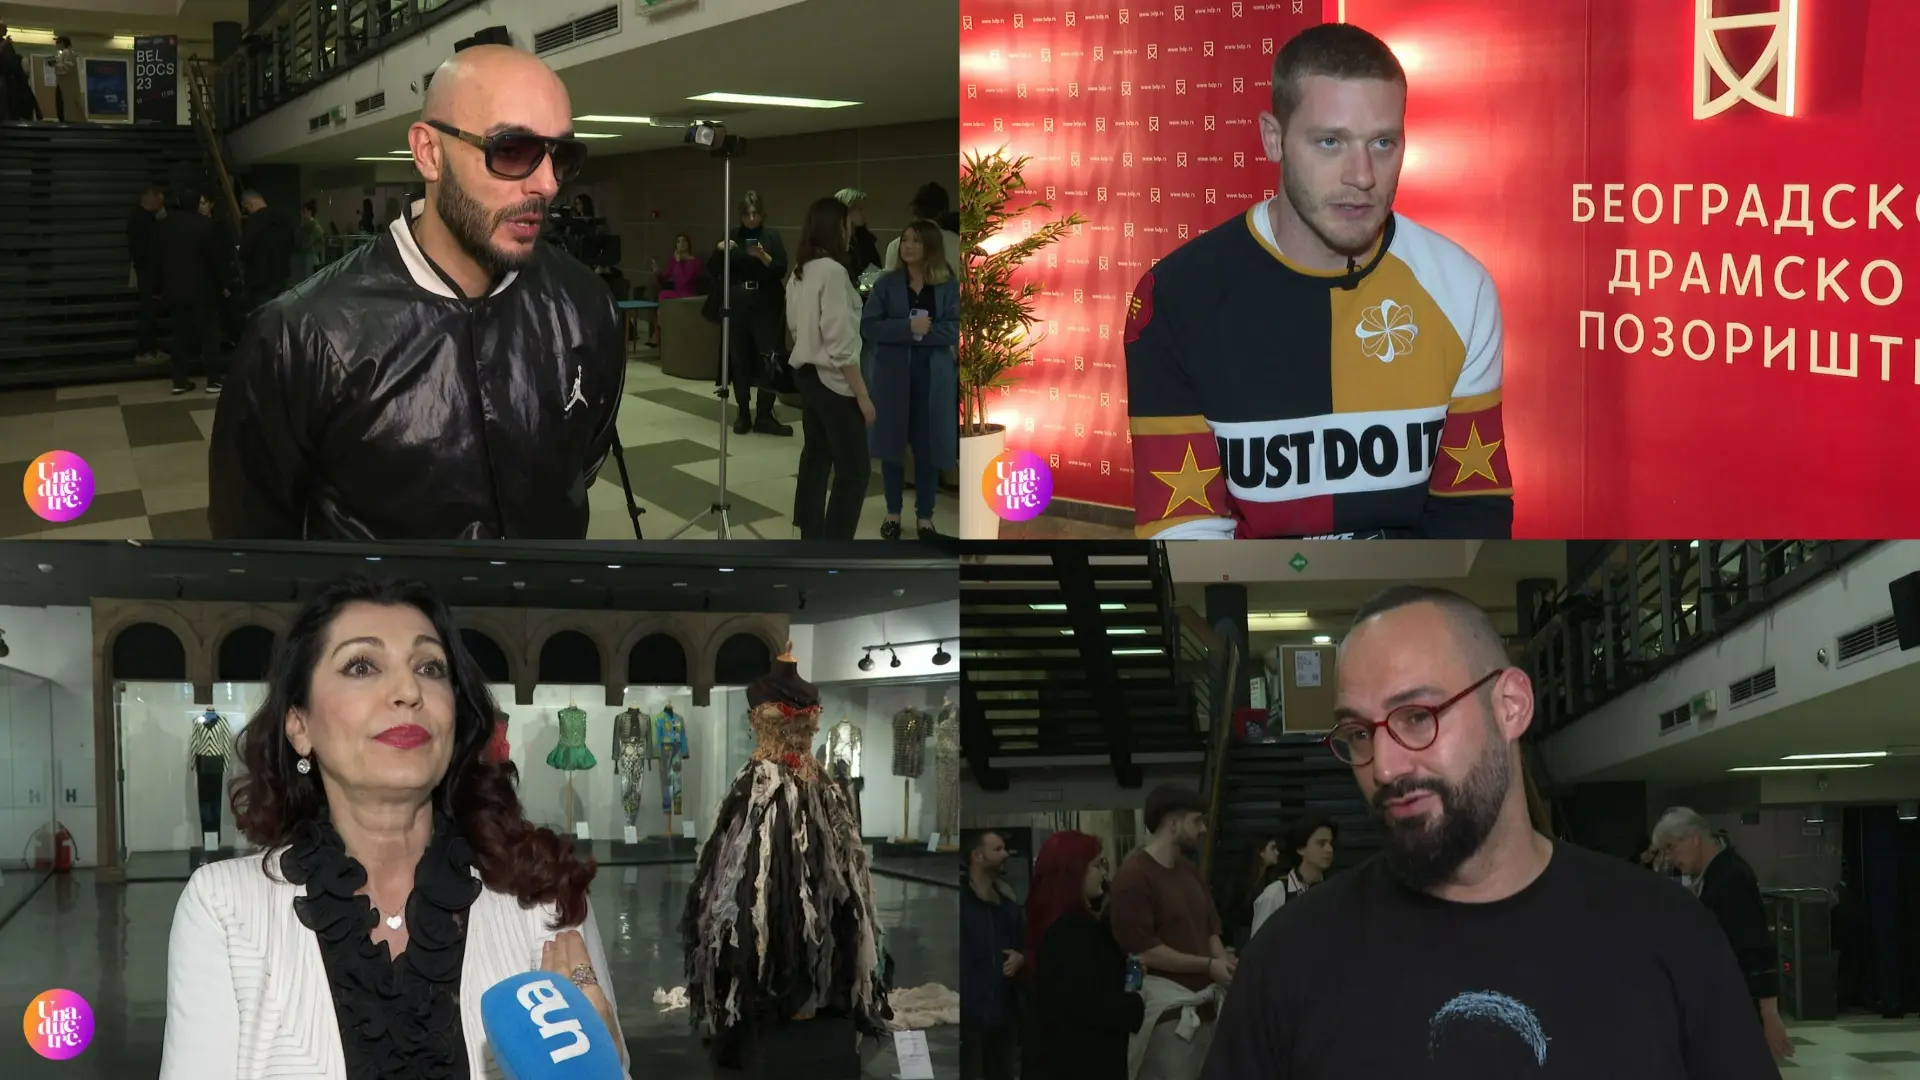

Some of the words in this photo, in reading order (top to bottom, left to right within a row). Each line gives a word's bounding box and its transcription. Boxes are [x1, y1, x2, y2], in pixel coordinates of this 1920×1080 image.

[1195, 7, 1221, 15] www.bdp.rs
[1253, 3, 1281, 11] www.bdp.rs
[1167, 45, 1193, 53] www.bdp.rs
[1224, 43, 1251, 51] www.bdp.rs
[136, 49, 163, 62] BEL
[1113, 48, 1137, 56] www.bdp.rs
[136, 63, 175, 76] DOCS
[136, 77, 152, 90] 23
[1140, 83, 1166, 91] www.bdp.rs
[1196, 81, 1223, 90] www.bdp.rs
[1115, 119, 1139, 127] www.bdp.rs
[1168, 118, 1194, 126] www.bdp.rs
[1225, 118, 1252, 126] www.bdp.rs
[1142, 155, 1167, 163] www.bdp.rs
[1197, 155, 1223, 163] www.bdp.rs
[1065, 189, 1089, 197] www.bdp.rs
[1116, 190, 1141, 198] www.bdp.rs
[1170, 191, 1196, 199] www.bdp.rs
[1226, 191, 1253, 200] www.bdp.rs
[1571, 182, 1920, 236] БЕОГРАДСК
[1143, 226, 1168, 234] www.bdp.rs
[1117, 260, 1142, 268] www.bdp.rs
[1608, 248, 1904, 306] ДРАМСКО
[1578, 310, 1920, 386] ПОЗОРИШТ
[1323, 424, 1399, 481] DO
[1406, 418, 1446, 473] IT
[66, 788, 77, 803] H
